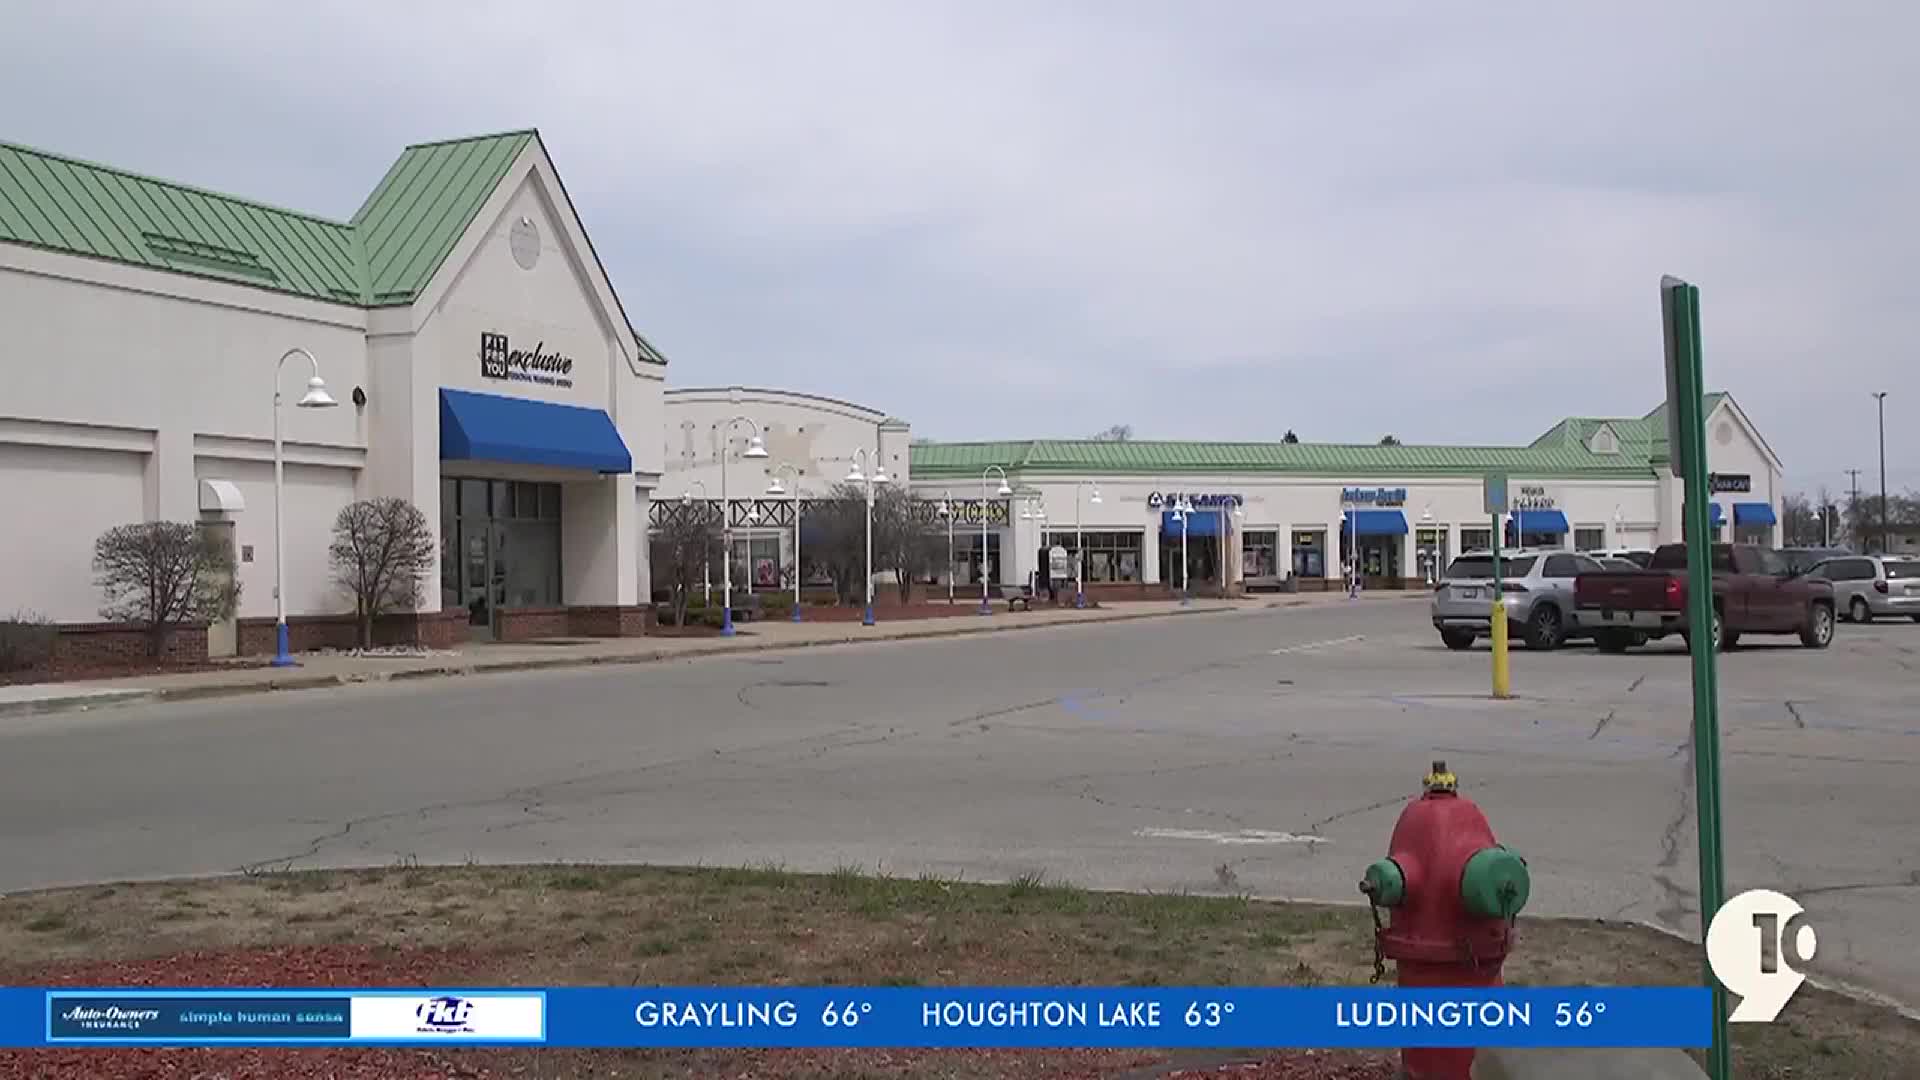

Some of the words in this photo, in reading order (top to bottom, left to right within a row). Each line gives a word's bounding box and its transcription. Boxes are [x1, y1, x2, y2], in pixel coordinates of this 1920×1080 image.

[485, 335, 505, 349] FIT
[485, 350, 505, 362] FOR
[508, 341, 573, 374] exclusive
[486, 362, 506, 376] YOU
